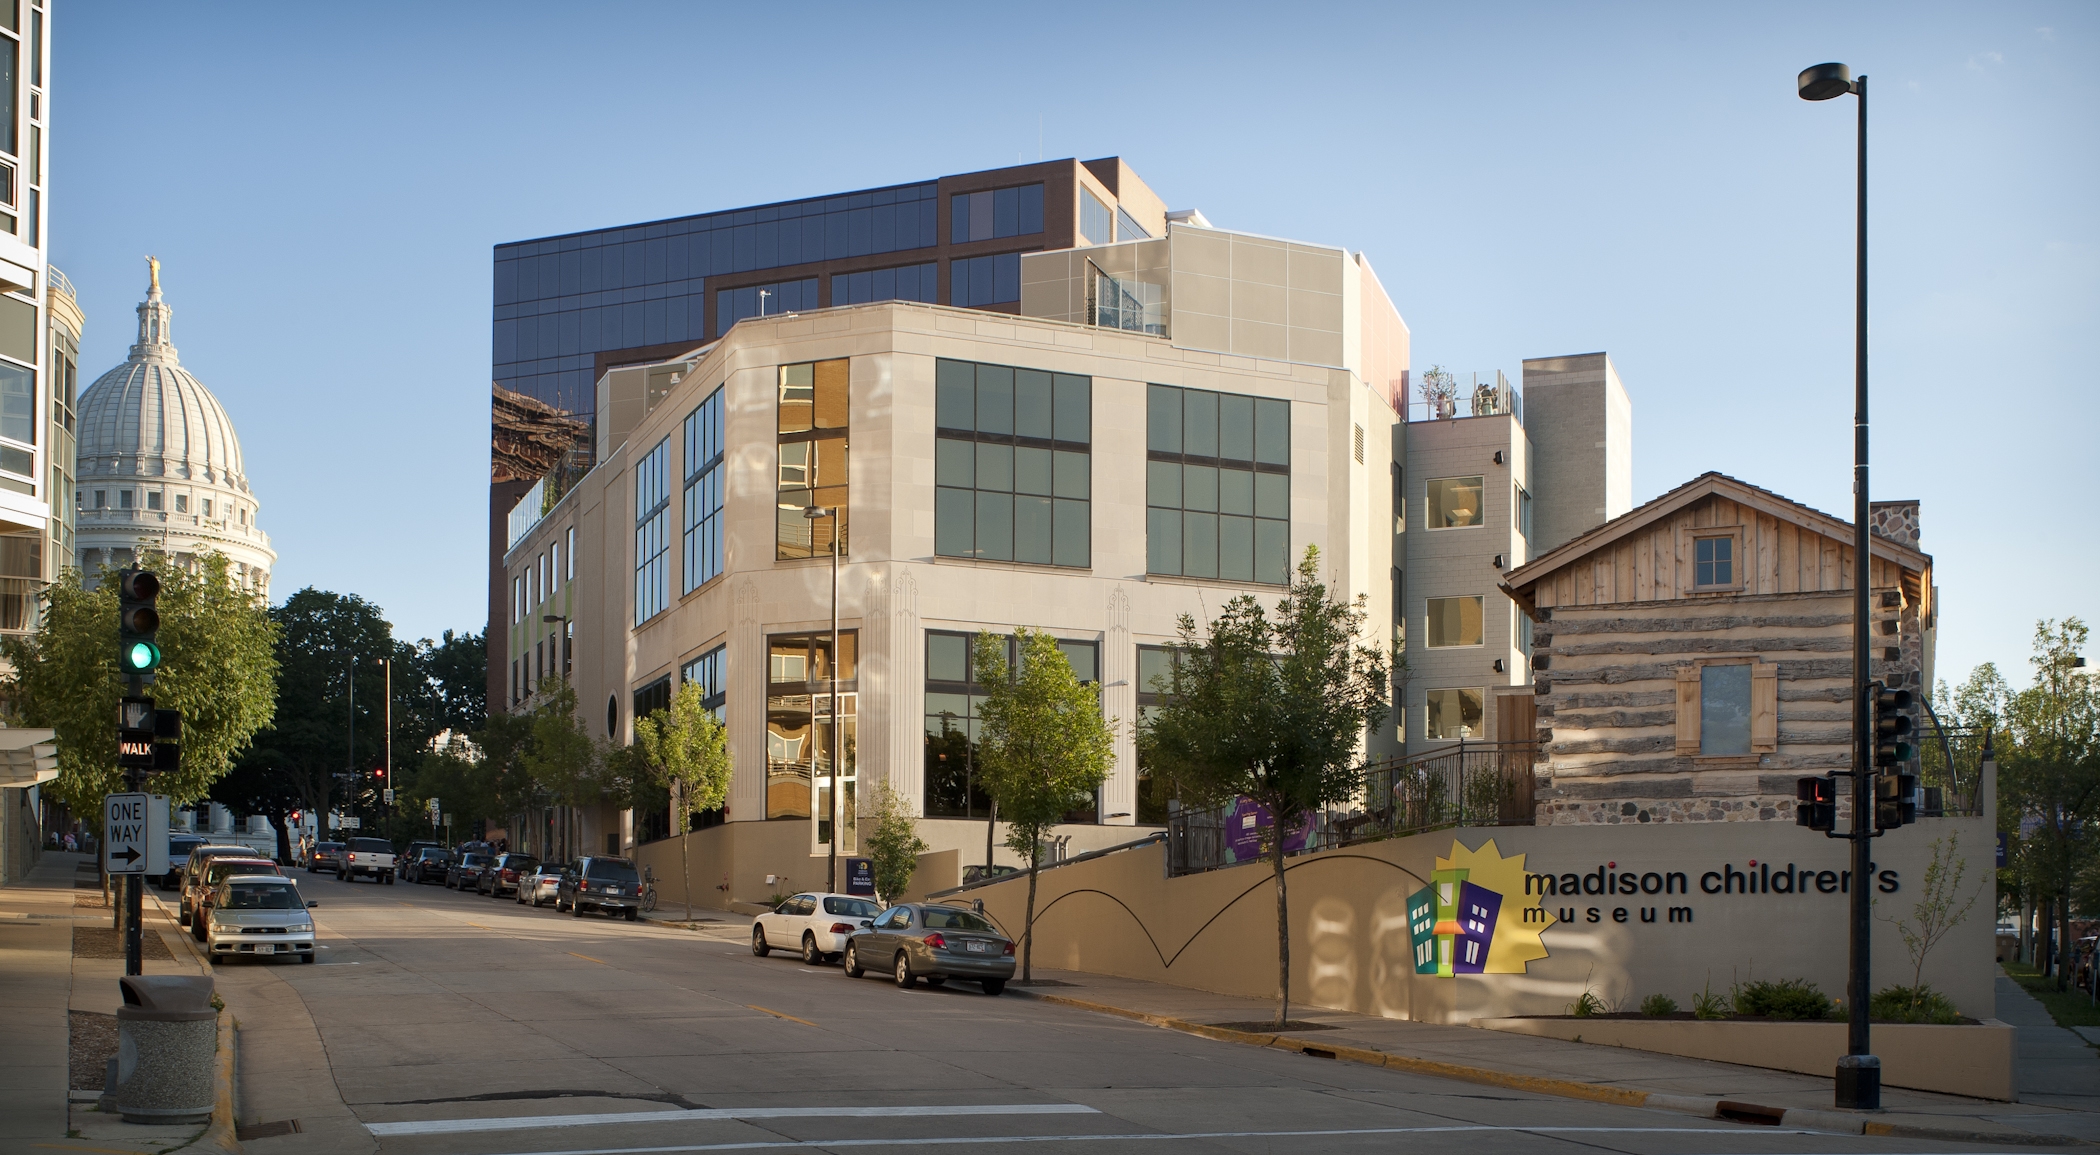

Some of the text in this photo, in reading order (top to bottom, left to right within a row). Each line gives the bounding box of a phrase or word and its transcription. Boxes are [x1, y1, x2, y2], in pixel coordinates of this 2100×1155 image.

[121, 743, 152, 755] WALK
[111, 803, 141, 820] ONE
[111, 825, 142, 842] WAY
[1525, 861, 1687, 895] madison
[1523, 906, 1692, 923] museum
